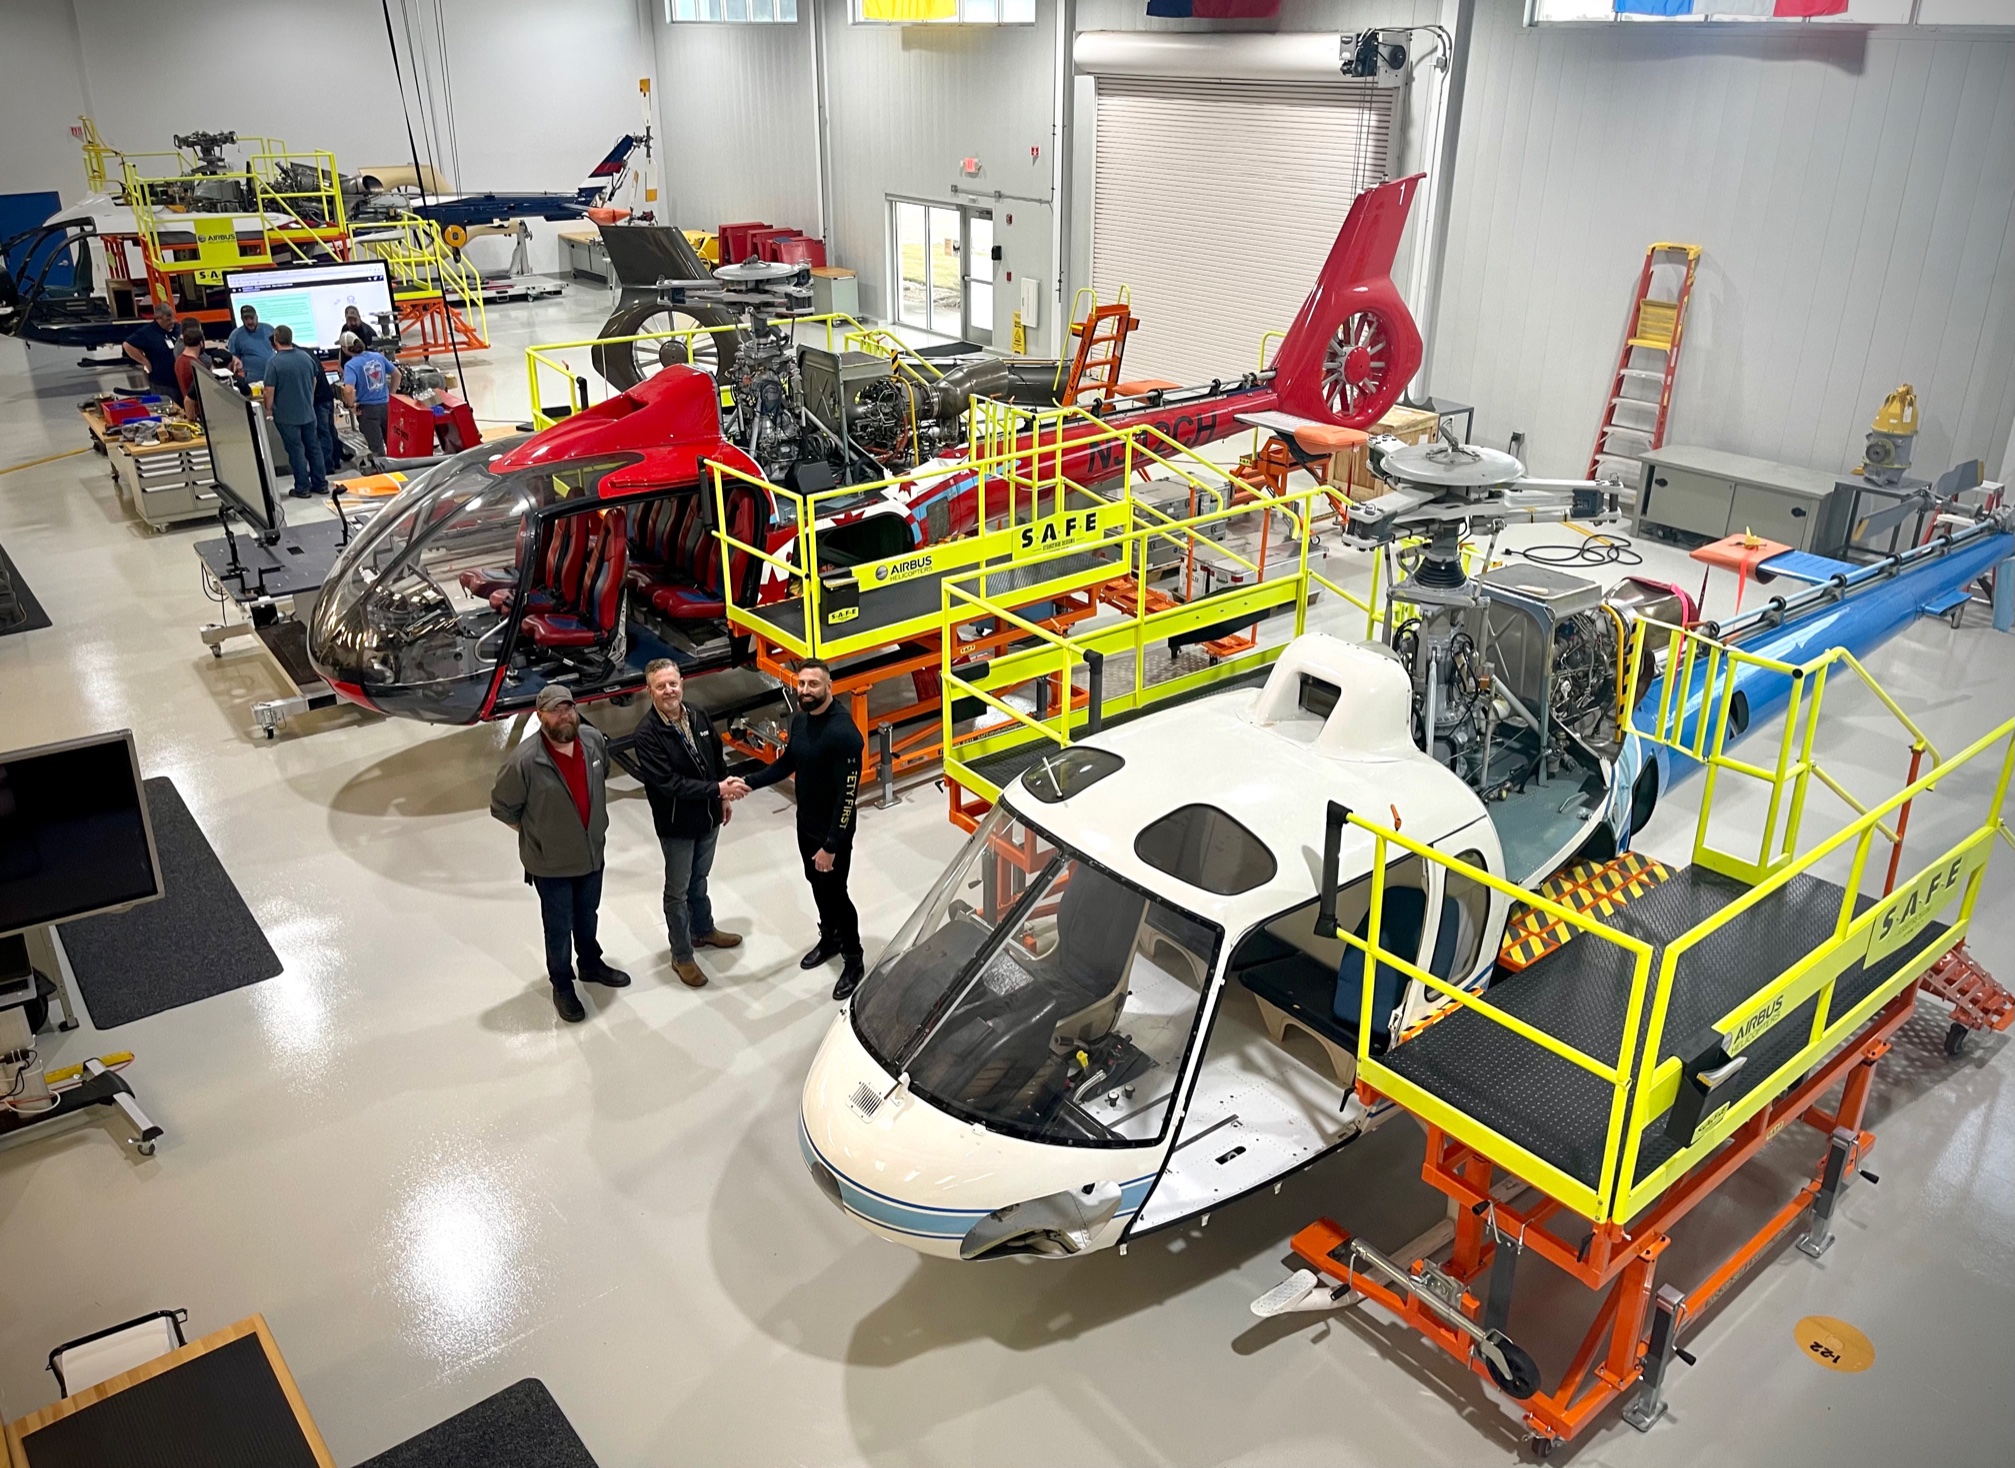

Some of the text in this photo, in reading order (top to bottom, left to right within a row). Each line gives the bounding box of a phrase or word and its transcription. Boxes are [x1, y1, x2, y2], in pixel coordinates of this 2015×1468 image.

[1399, 182, 1406, 206] 1
[207, 233, 236, 241] AIRBUS
[890, 555, 932, 575] AIRBUS
[890, 566, 933, 581] HELICOPTERS
[839, 770, 858, 829] ETY FIRST
[1734, 994, 1784, 1045] AIRBUS
[1731, 1011, 1781, 1055] HELICOPTERS
[1809, 1341, 1841, 1364] 1-22
